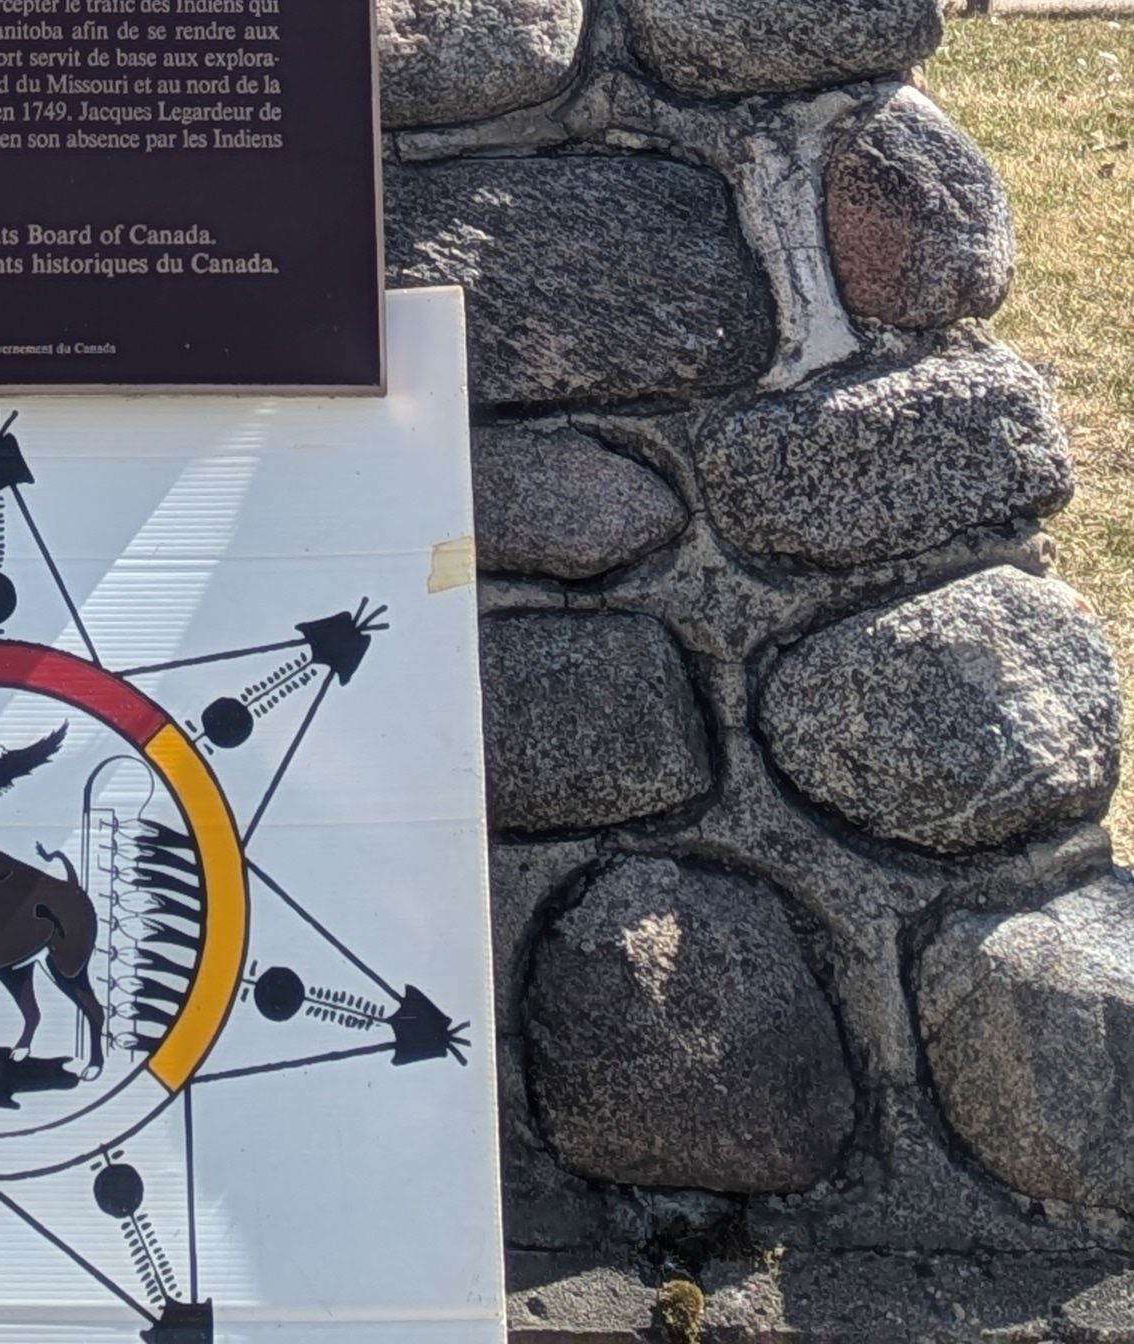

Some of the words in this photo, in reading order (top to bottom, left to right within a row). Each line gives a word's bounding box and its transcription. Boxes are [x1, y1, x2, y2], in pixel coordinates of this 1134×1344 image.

[71, 19, 110, 41] afin
[116, 20, 140, 41] de
[147, 25, 168, 41] se
[174, 20, 237, 41] rendre
[243, 25, 281, 41] aux
[21, 100, 73, 122] 1749.
[77, 100, 153, 126] Jacques
[157, 100, 255, 126] Legardeur
[258, 101, 282, 122] de
[26, 133, 61, 149] son
[65, 128, 141, 149] absence
[145, 133, 178, 153] par
[182, 128, 208, 149] les
[212, 127, 284, 149] Indiens
[26, 223, 93, 246] Board
[99, 223, 126, 246] of
[128, 223, 217, 246] Canada.
[30, 252, 150, 279] historiques
[155, 252, 185, 275] du
[190, 252, 280, 275] Canada.
[55, 342, 72, 355] du
[73, 341, 117, 355] Canada
